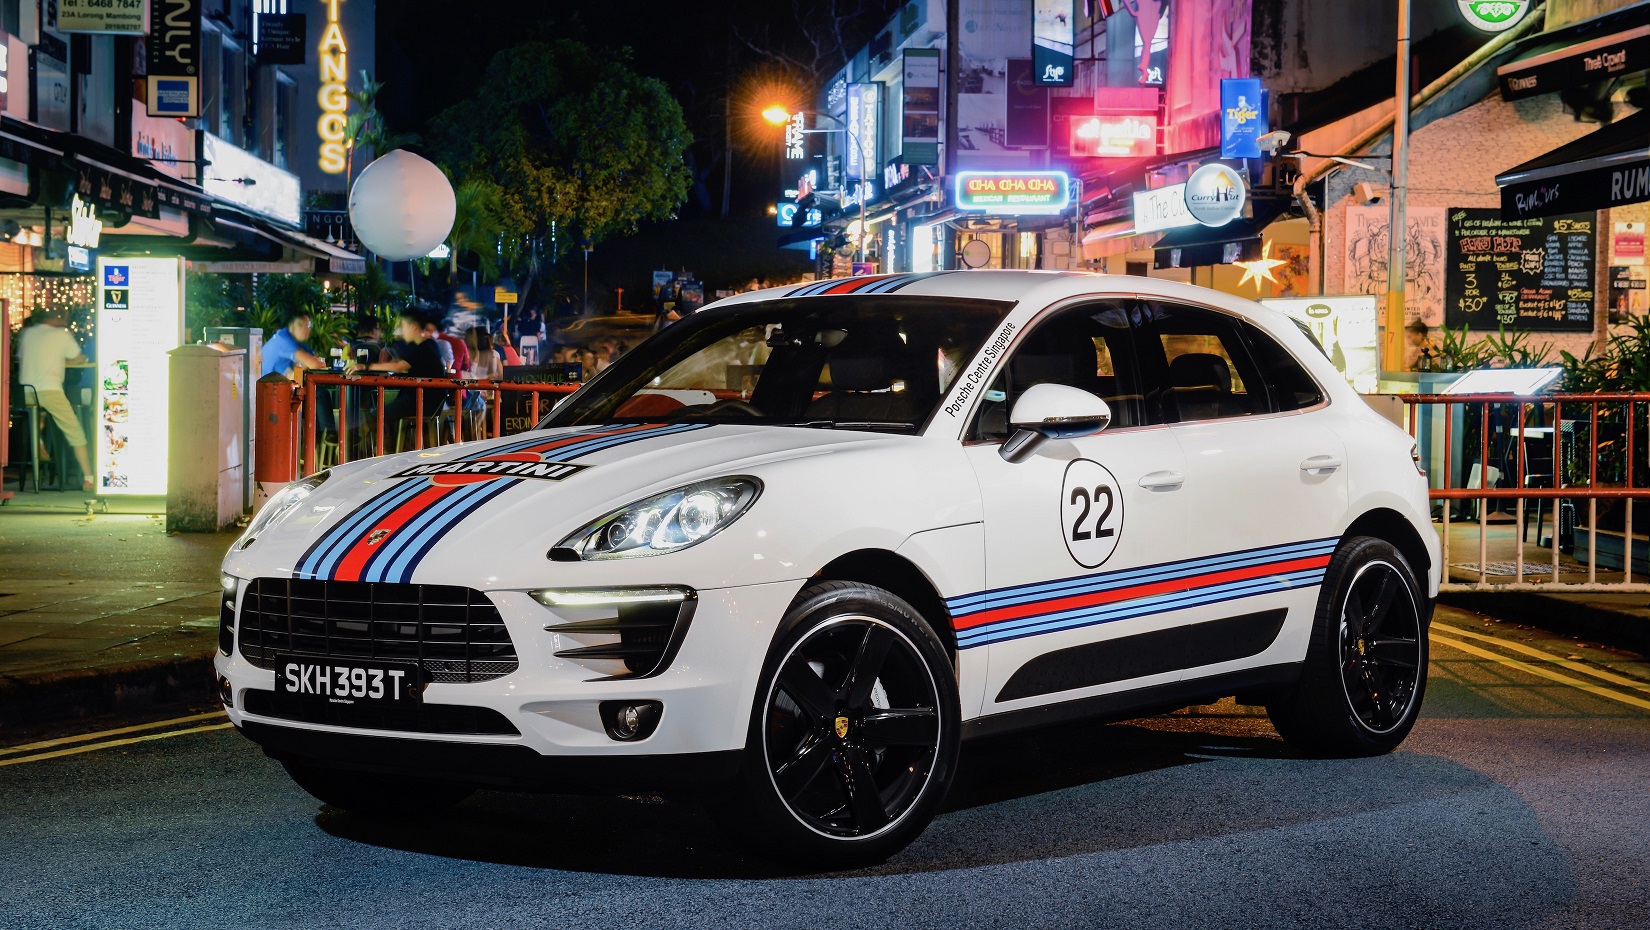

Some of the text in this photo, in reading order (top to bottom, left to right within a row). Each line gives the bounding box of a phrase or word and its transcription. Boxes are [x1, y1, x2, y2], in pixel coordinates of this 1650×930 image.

[77, 11, 104, 19] Lorong
[106, 12, 141, 20] Mambong
[318, 0, 348, 173] TANGOS
[1227, 107, 1258, 124] Tiger
[969, 179, 1055, 191] CHA CHA CHA
[1611, 166, 1650, 201] RUM
[1149, 195, 1169, 219] The
[1464, 273, 1478, 288] 3
[1465, 289, 1480, 297] FOR
[945, 322, 1016, 417] Porsche Centre Singapore
[402, 461, 577, 477] MARTINI
[1070, 484, 1114, 541] 22
